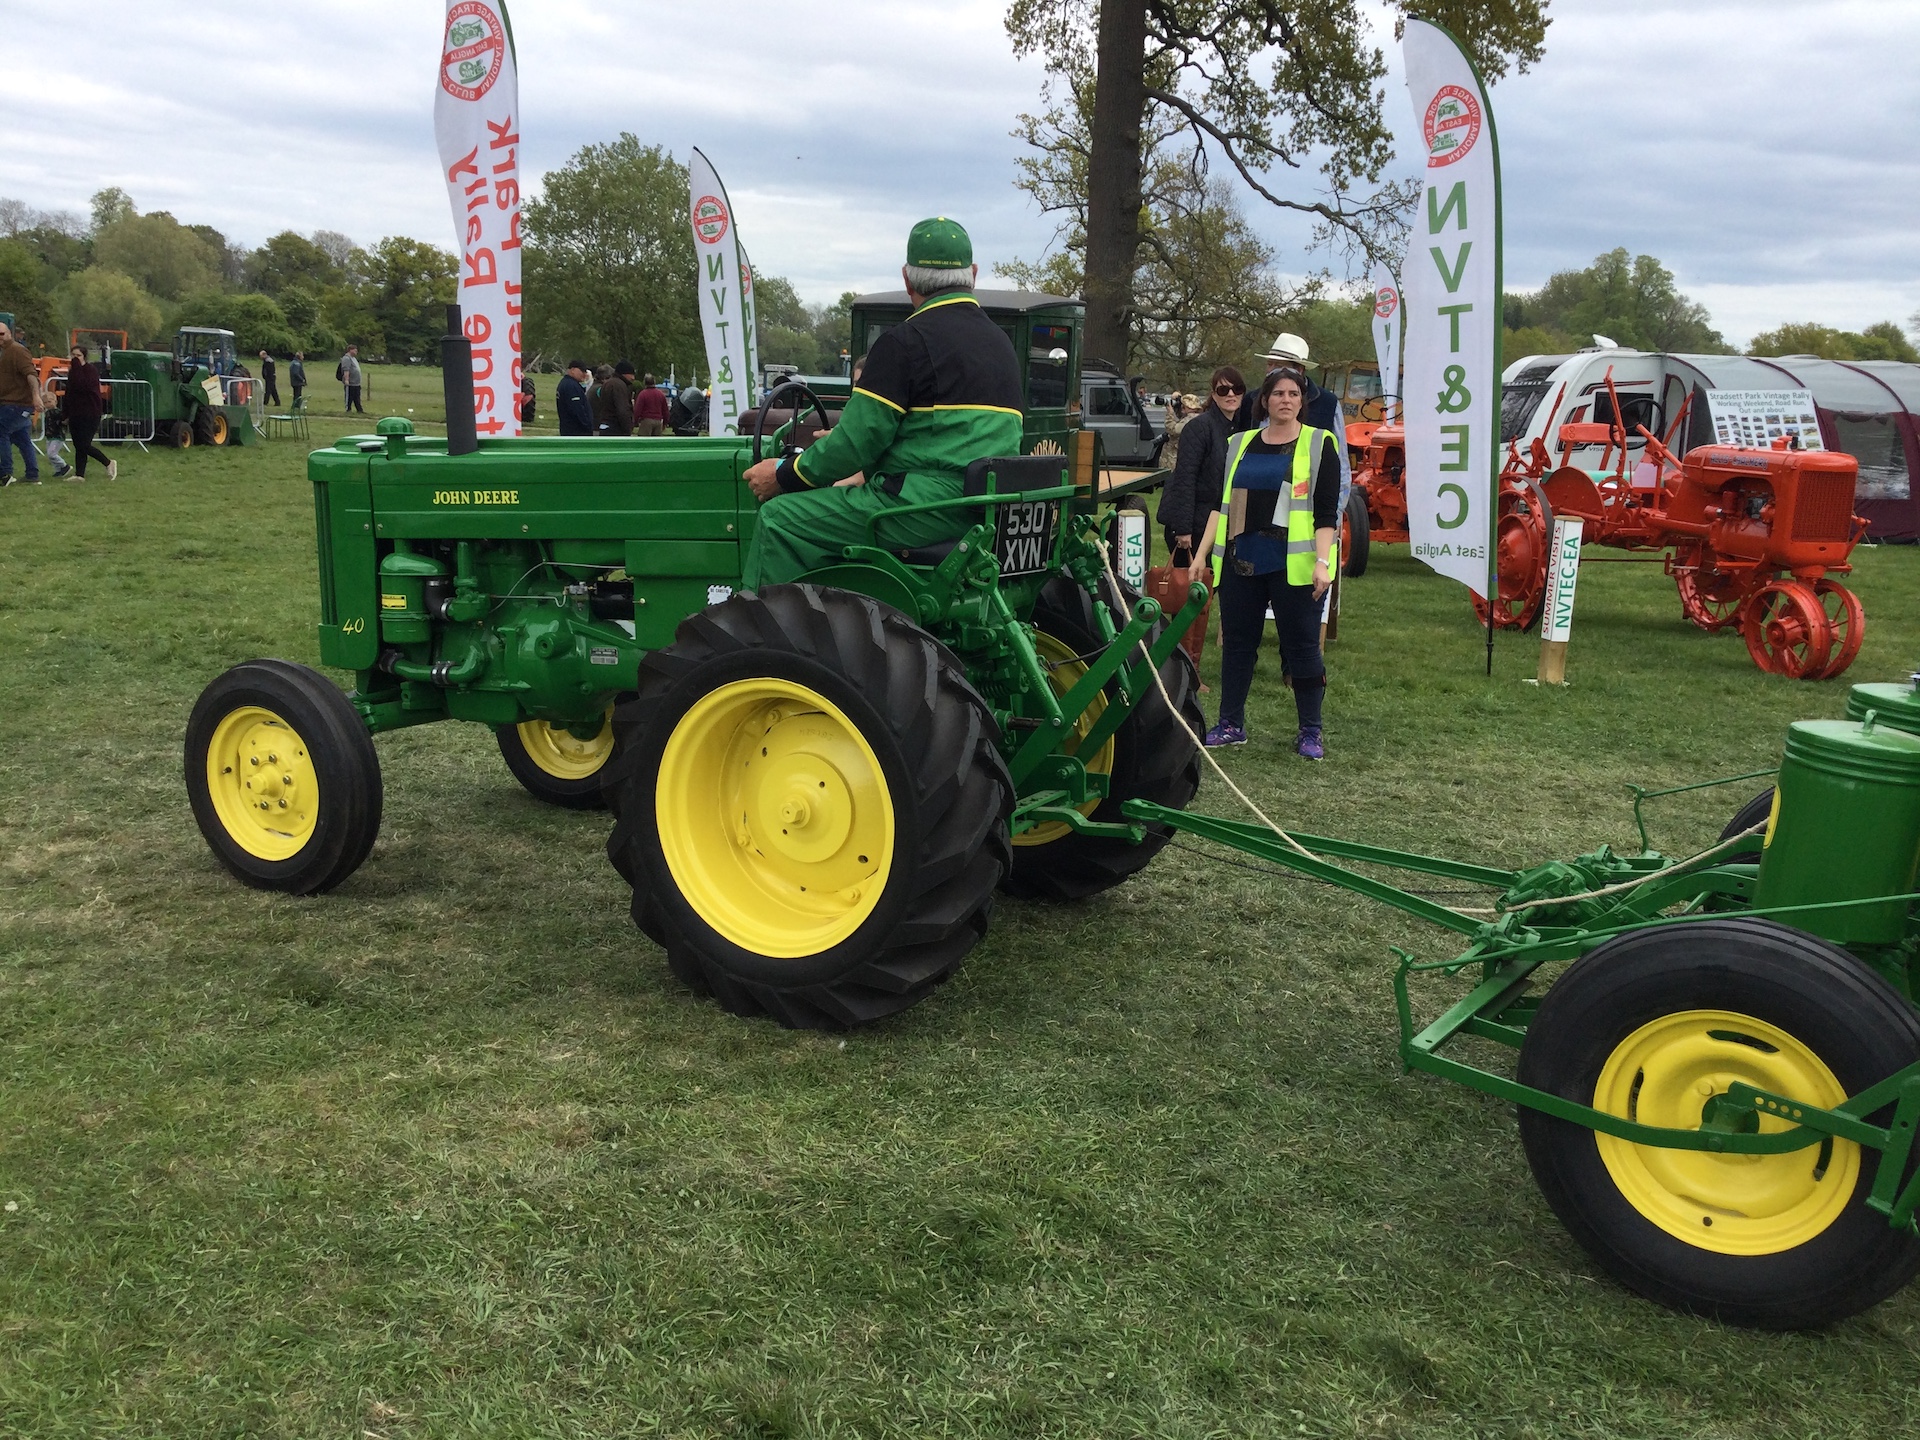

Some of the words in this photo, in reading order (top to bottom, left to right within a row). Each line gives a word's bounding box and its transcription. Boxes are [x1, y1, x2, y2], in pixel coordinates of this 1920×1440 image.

[1709, 392, 1743, 400] Stradsett
[1745, 392, 1761, 400] Park
[1763, 392, 1790, 400] Vintage
[1792, 392, 1810, 400] Rally
[433, 491, 470, 505] JOHN
[473, 490, 520, 505] DEERE
[1006, 501, 1046, 536] 530
[1003, 537, 1042, 572] XVN
[1127, 532, 1143, 588] EC-EA
[1543, 571, 1556, 634] SUMMER
[1550, 526, 1561, 567] VISITS
[1555, 536, 1580, 629] NVTEC-EA
[342, 616, 365, 636] 40
